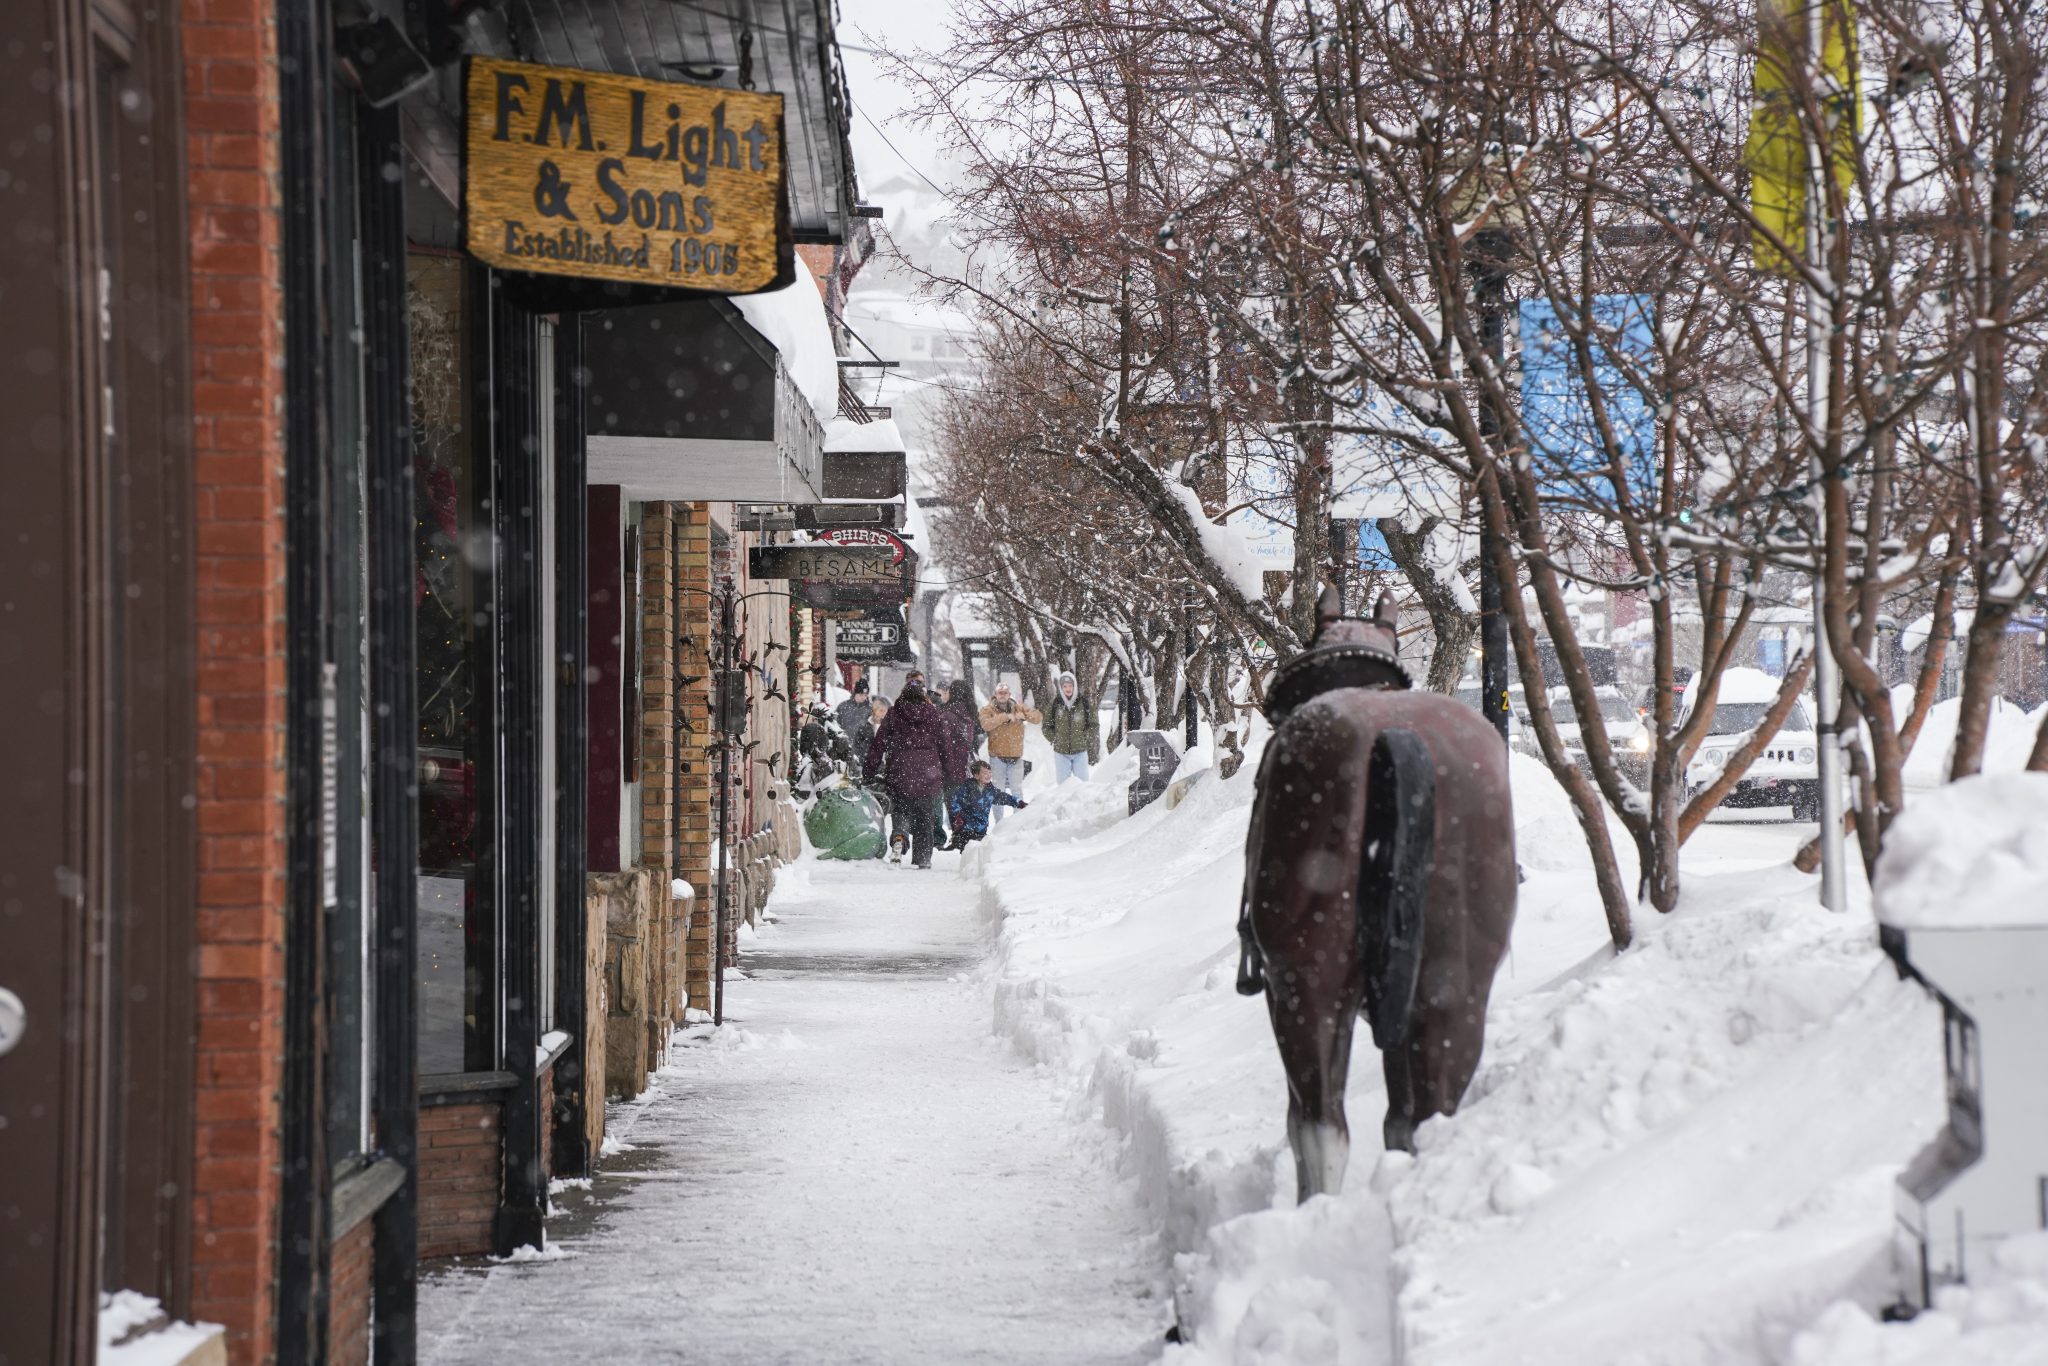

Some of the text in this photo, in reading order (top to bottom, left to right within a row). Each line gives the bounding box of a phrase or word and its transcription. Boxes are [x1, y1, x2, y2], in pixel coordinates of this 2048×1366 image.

[627, 89, 769, 187] Light
[534, 157, 714, 234] & Sons
[504, 220, 649, 268] Established
[832, 529, 888, 546] SHIRTS
[841, 621, 875, 630] DINNER
[842, 633, 875, 642] LUNCH
[836, 646, 881, 655] REAKFAST
